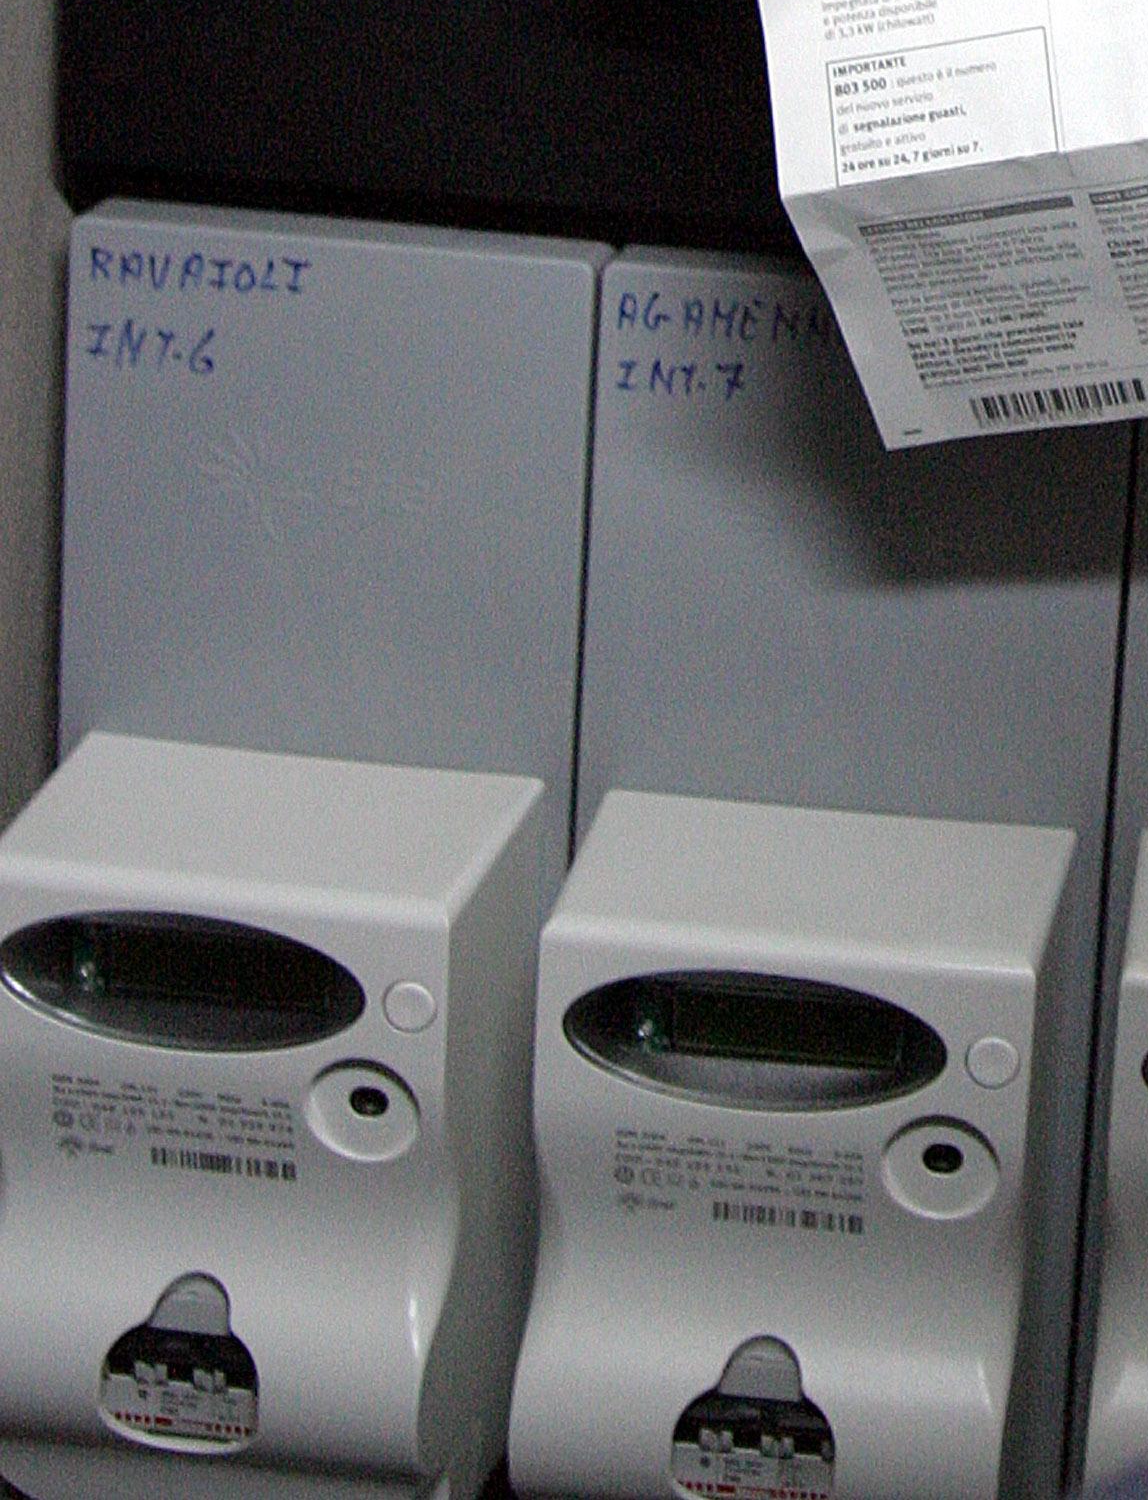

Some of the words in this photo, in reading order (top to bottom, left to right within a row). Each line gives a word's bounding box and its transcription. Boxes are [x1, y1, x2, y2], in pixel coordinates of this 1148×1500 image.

[833, 56, 905, 77] IMPORTANTE
[835, 82, 859, 96] 803
[863, 77, 887, 92] 500
[853, 113, 926, 132] segnalazione
